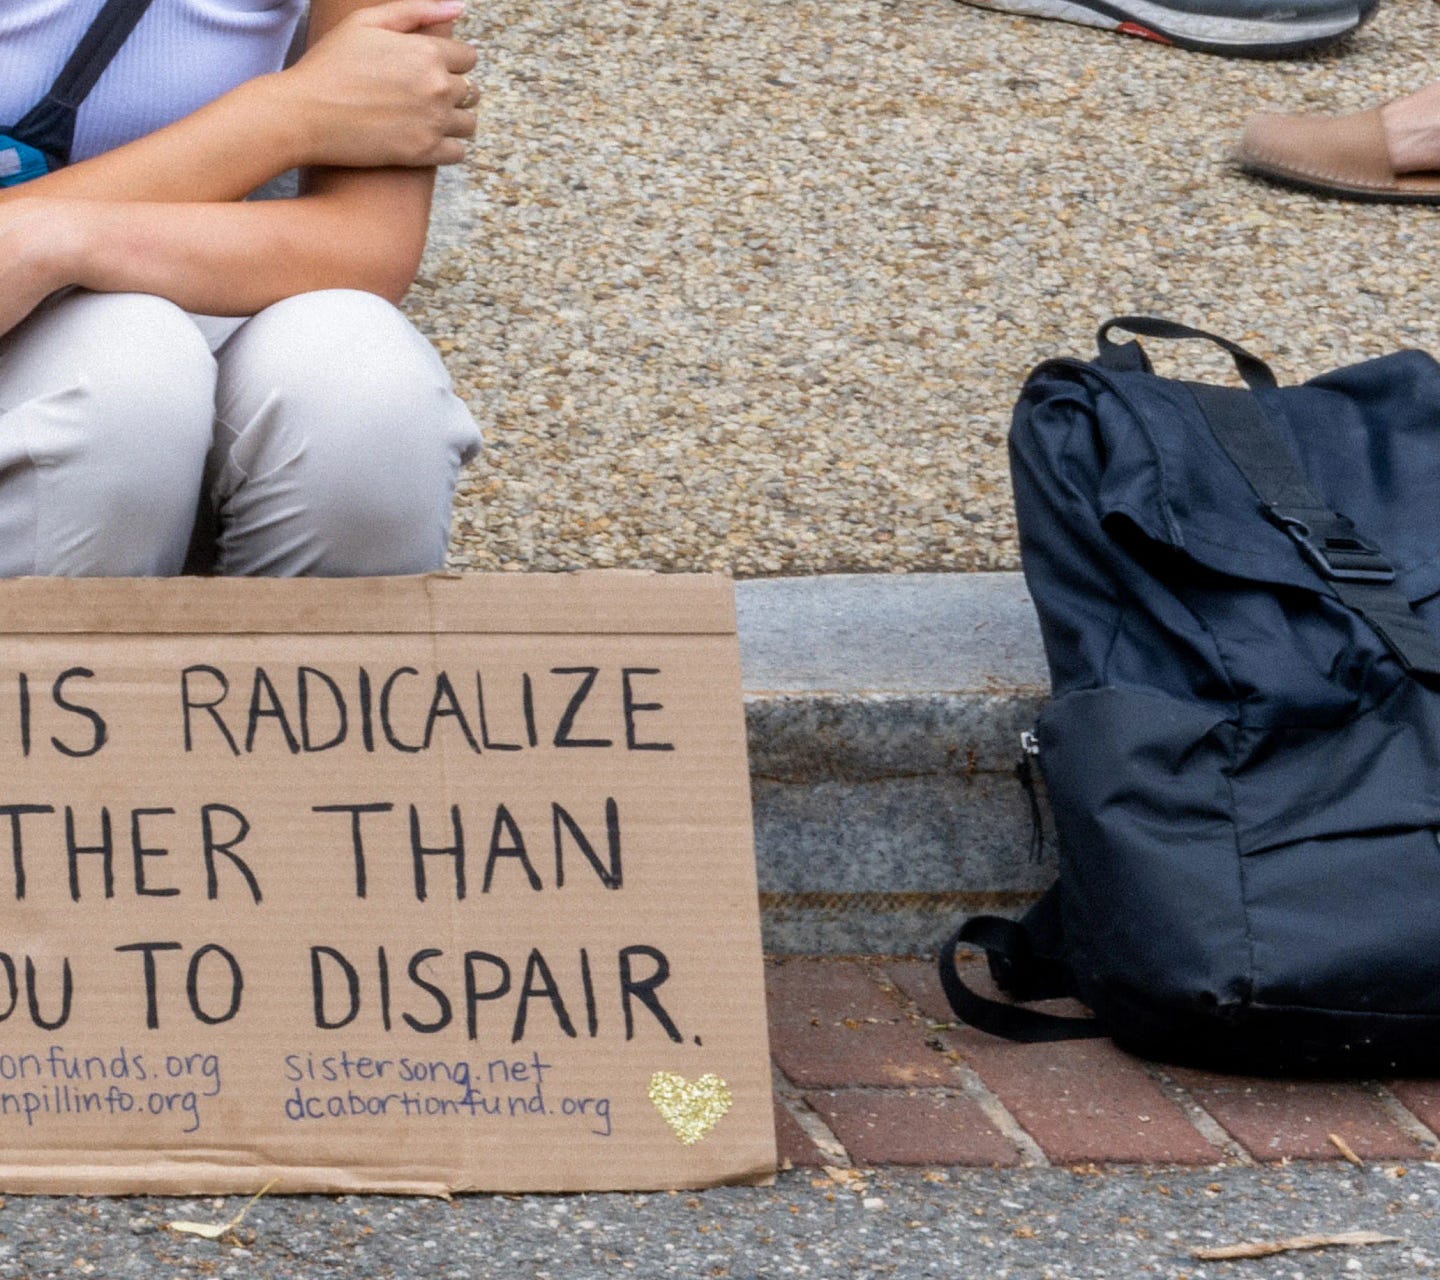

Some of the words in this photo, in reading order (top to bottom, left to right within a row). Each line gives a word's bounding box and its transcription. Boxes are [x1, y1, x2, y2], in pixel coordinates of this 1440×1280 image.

[182, 665, 674, 755] RADICALIZE
[312, 798, 622, 902] THAN
[115, 942, 243, 1028] TO
[311, 945, 702, 1046] DISPAIR.
[285, 1085, 611, 1137] dcabortionfund.org
